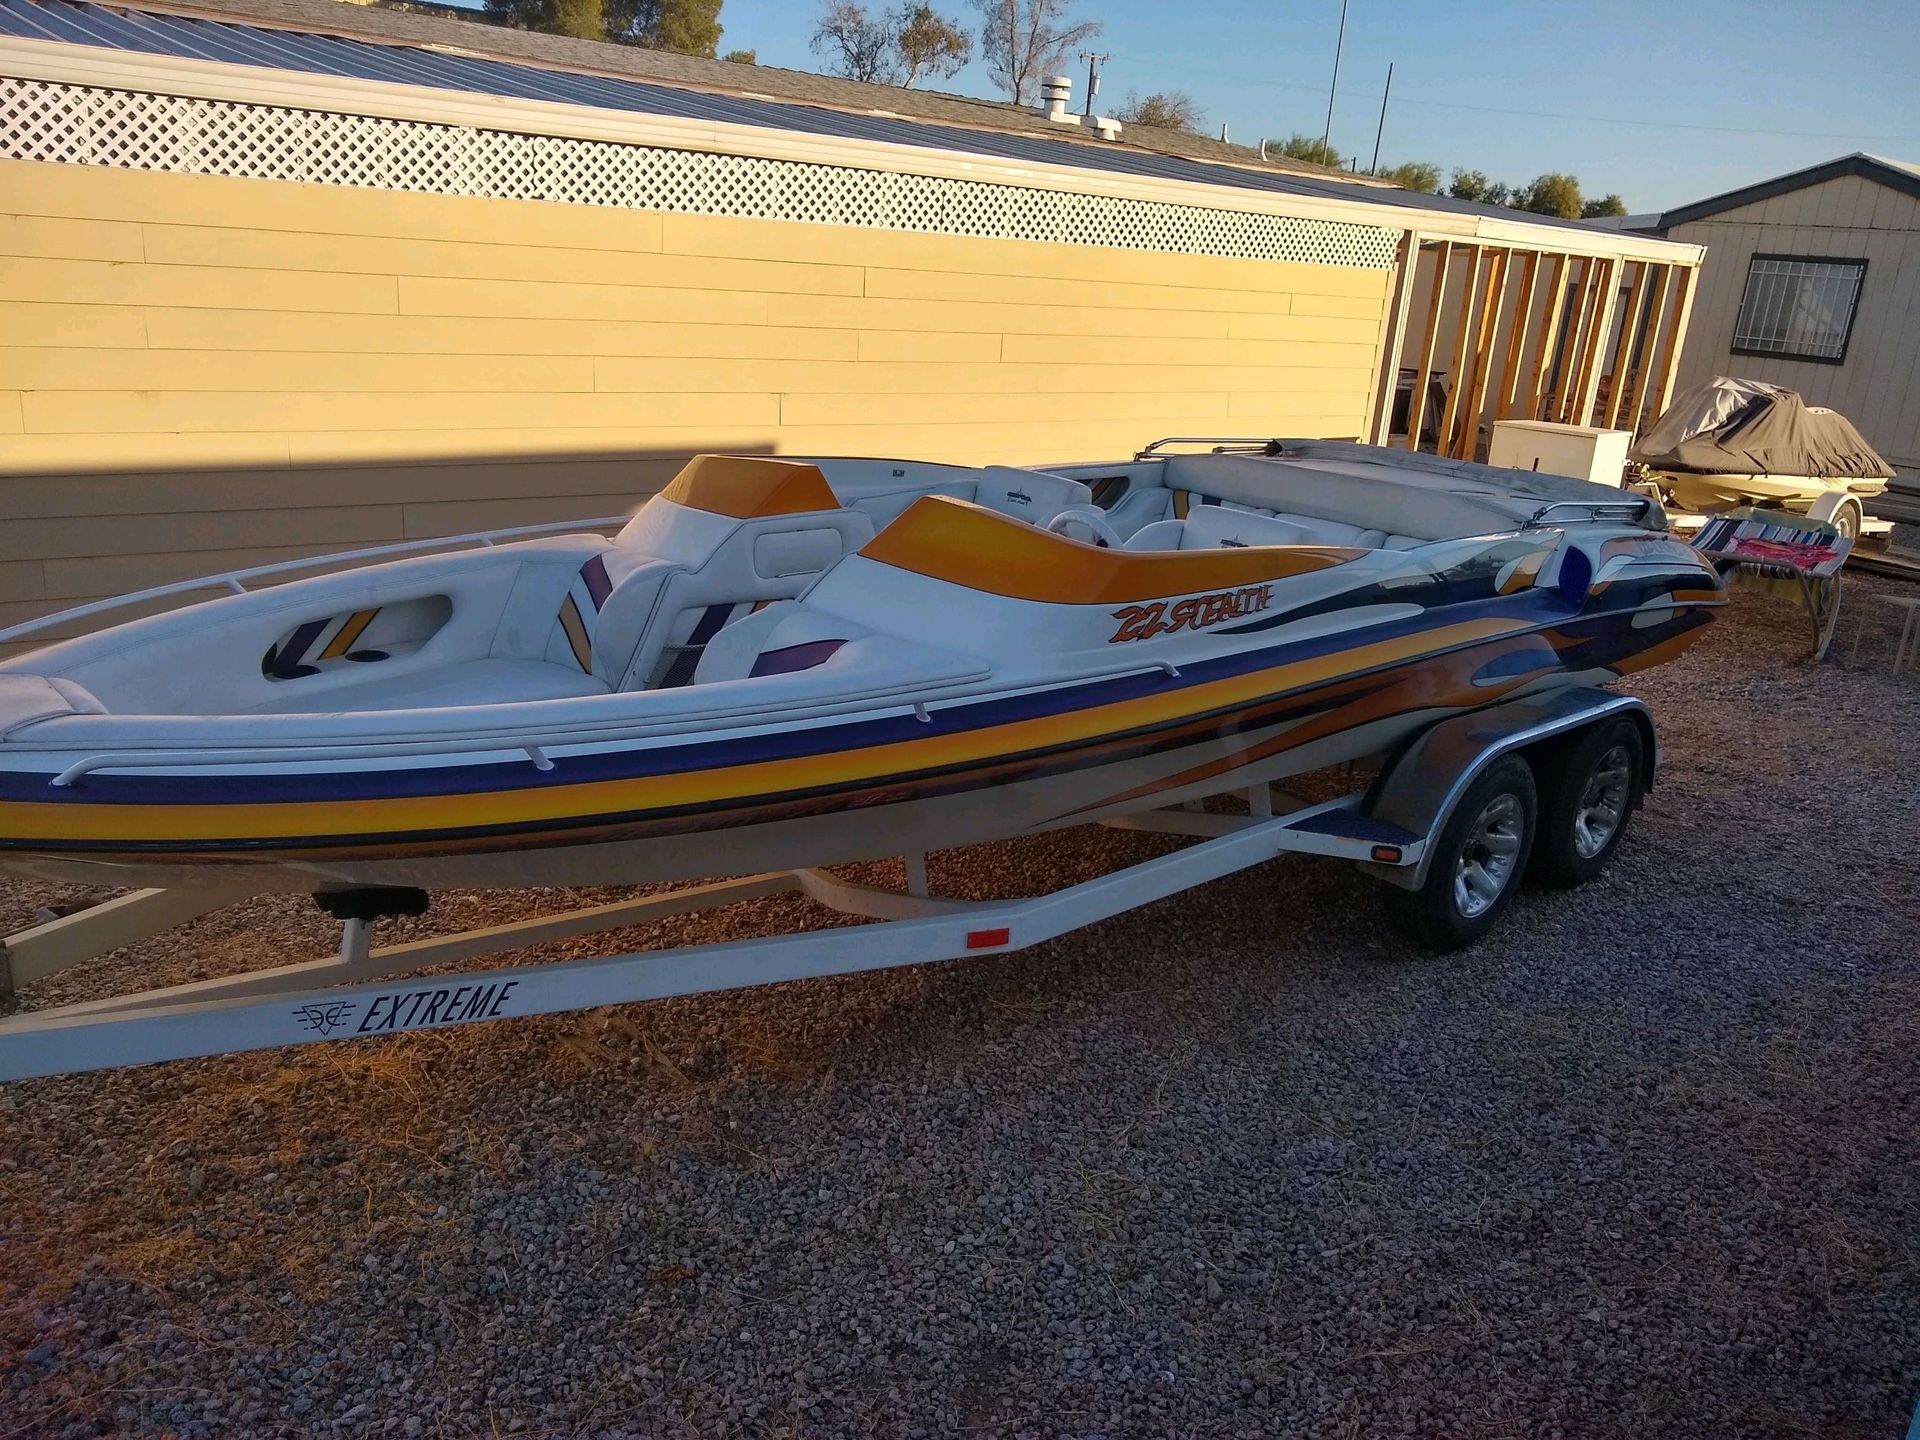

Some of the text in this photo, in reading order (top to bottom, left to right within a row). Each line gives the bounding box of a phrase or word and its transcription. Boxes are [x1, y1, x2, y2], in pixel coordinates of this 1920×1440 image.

[1108, 585, 1274, 643] 22 STEALTH
[357, 981, 520, 1033] EXTREME
